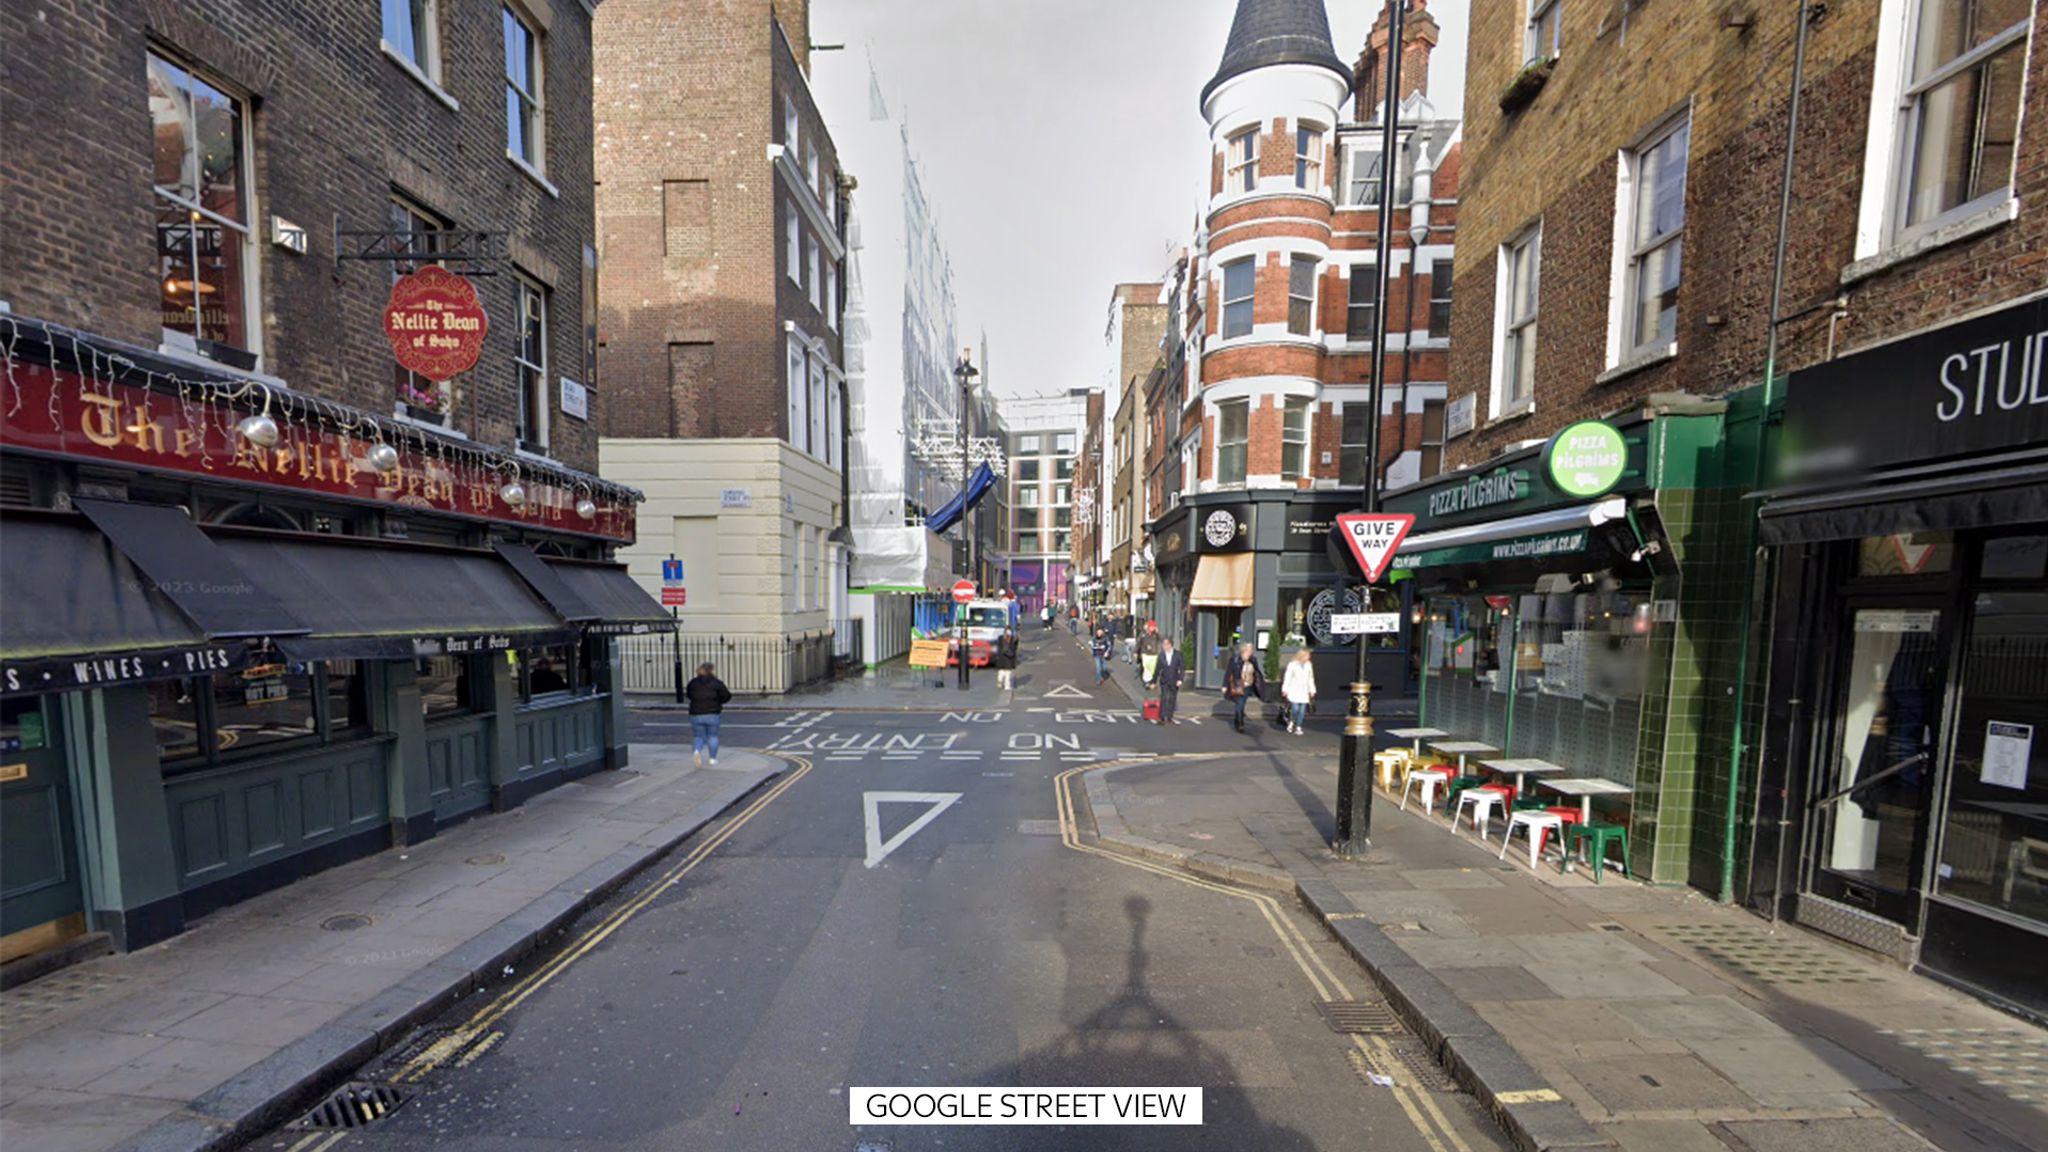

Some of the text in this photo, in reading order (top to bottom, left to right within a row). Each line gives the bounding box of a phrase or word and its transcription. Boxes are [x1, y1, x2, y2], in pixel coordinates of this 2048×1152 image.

[426, 300, 443, 311] The
[391, 312, 480, 331] Nellie Dean
[413, 334, 460, 349] of Soho
[80, 392, 197, 458] The
[1569, 436, 1606, 450] PIZZA
[1556, 451, 1619, 468] PILGRIMS
[1429, 472, 1518, 517] PIZZA PILGRIMS
[1353, 521, 1395, 536] GIVE
[1362, 538, 1389, 549] WAY
[0, 649, 229, 692] S WINES PIES
[939, 711, 1202, 725] NO ENTY
[791, 732, 1080, 751] NO ENTRY
